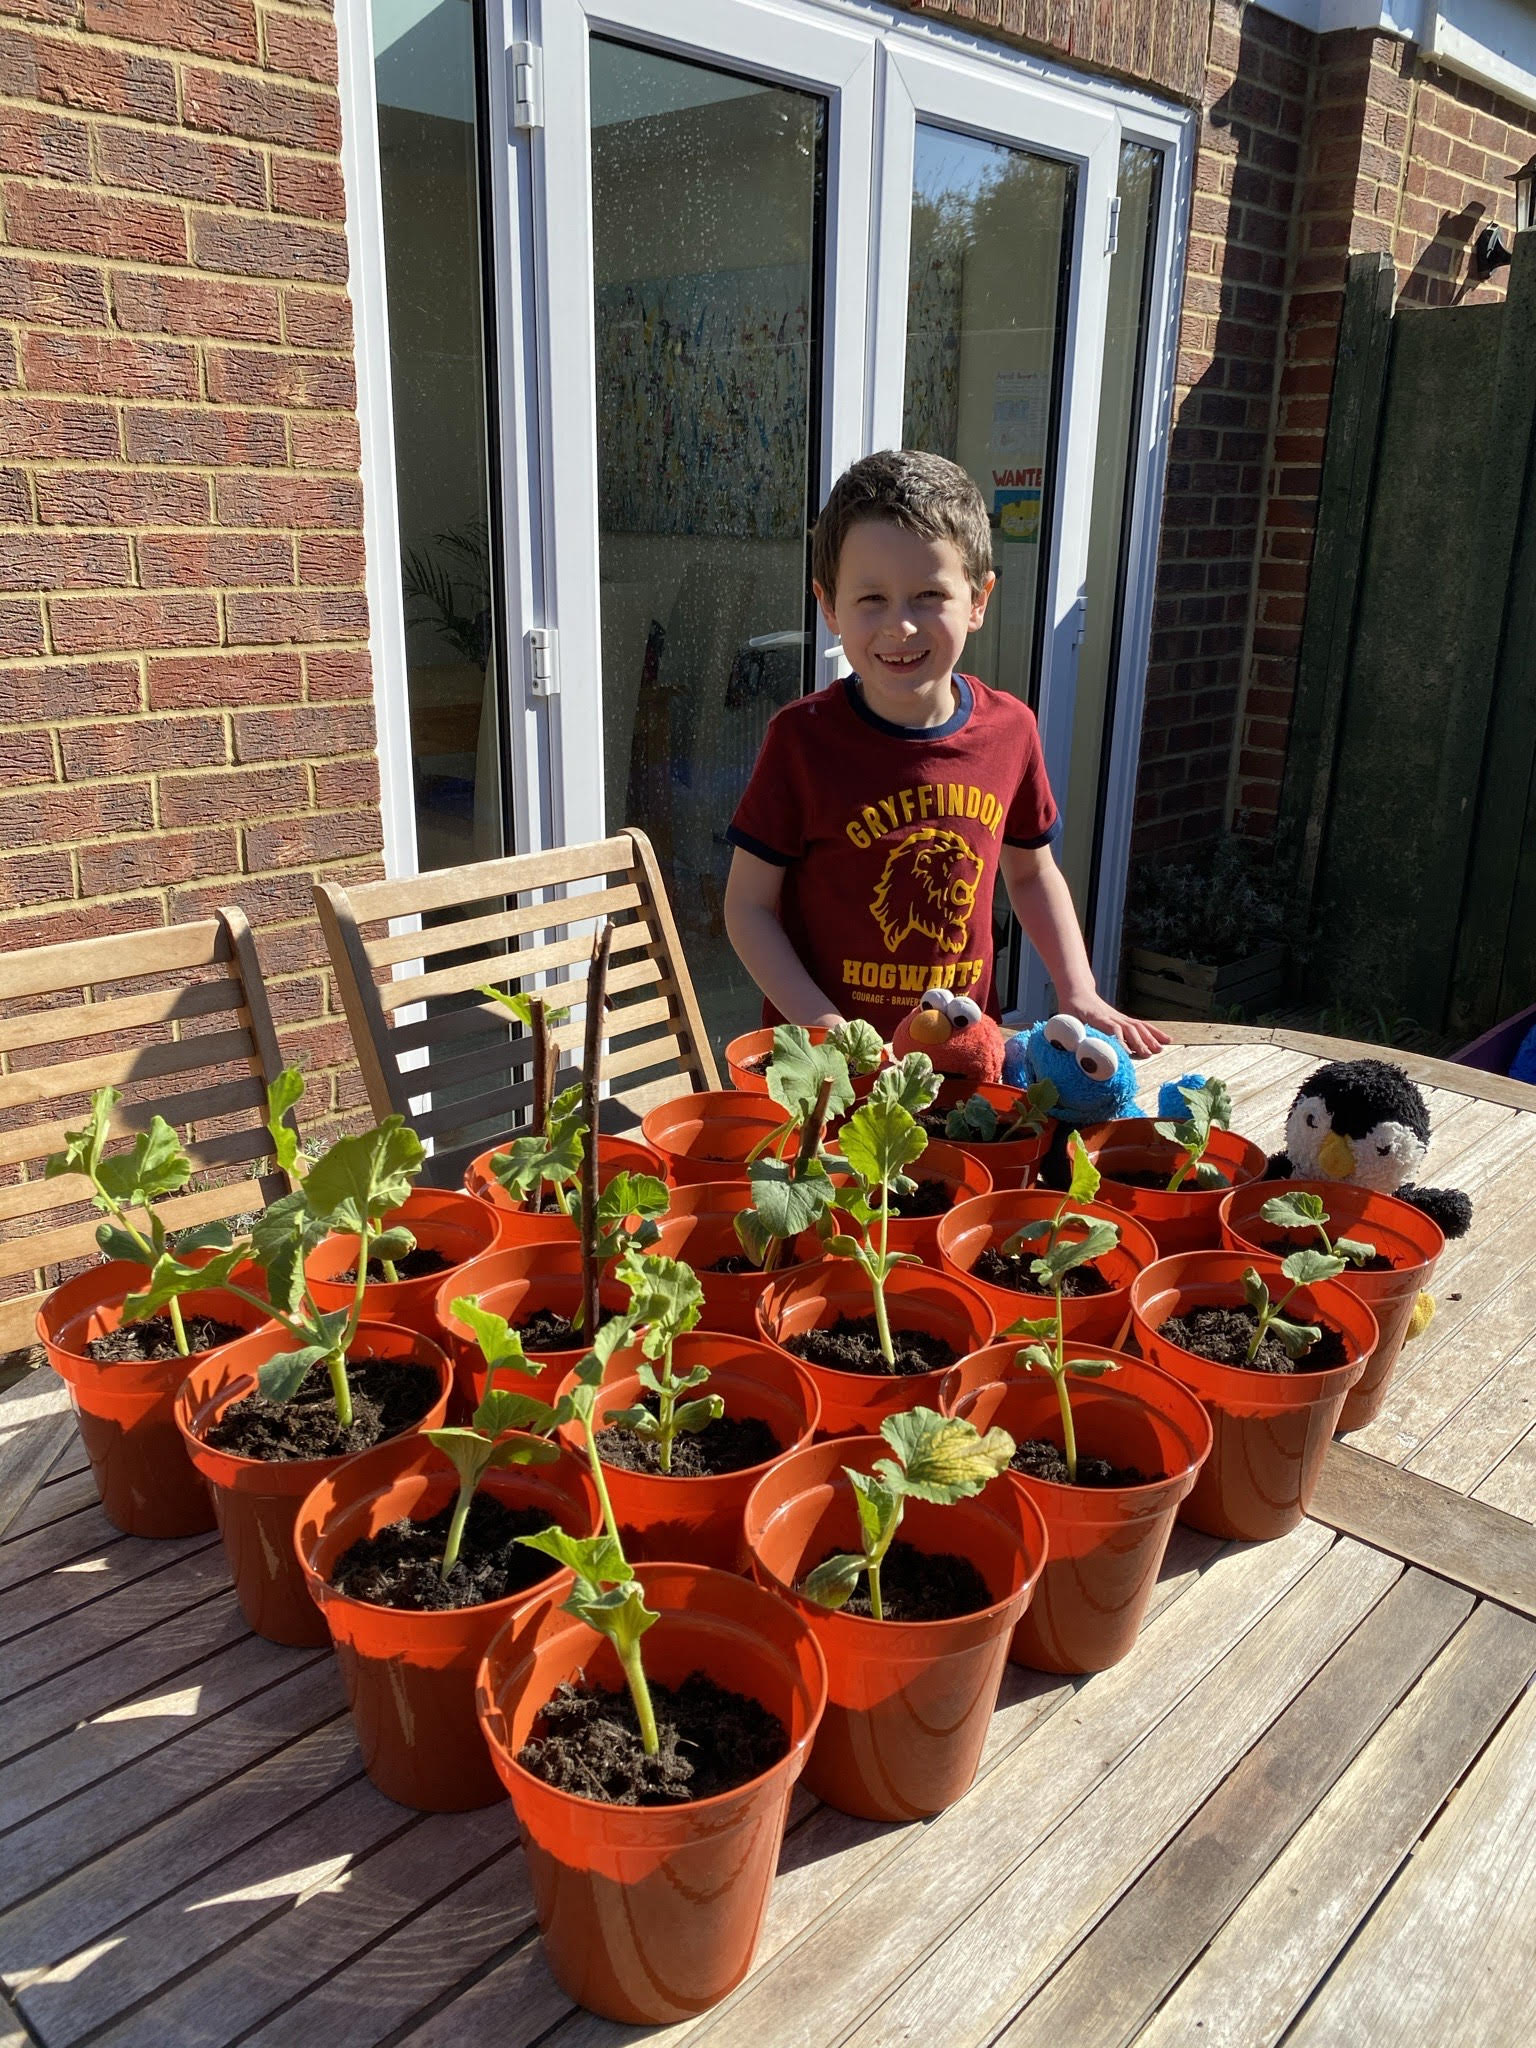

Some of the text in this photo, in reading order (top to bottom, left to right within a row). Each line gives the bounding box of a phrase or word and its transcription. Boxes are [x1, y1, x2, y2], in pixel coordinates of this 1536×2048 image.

[992, 467, 1042, 487] WANTE
[846, 783, 1004, 848] GRYFFINDOR
[842, 959, 984, 991] HOGWARTS
[852, 991, 885, 1004] COURAGE
[891, 995, 922, 1007] BRAVER
